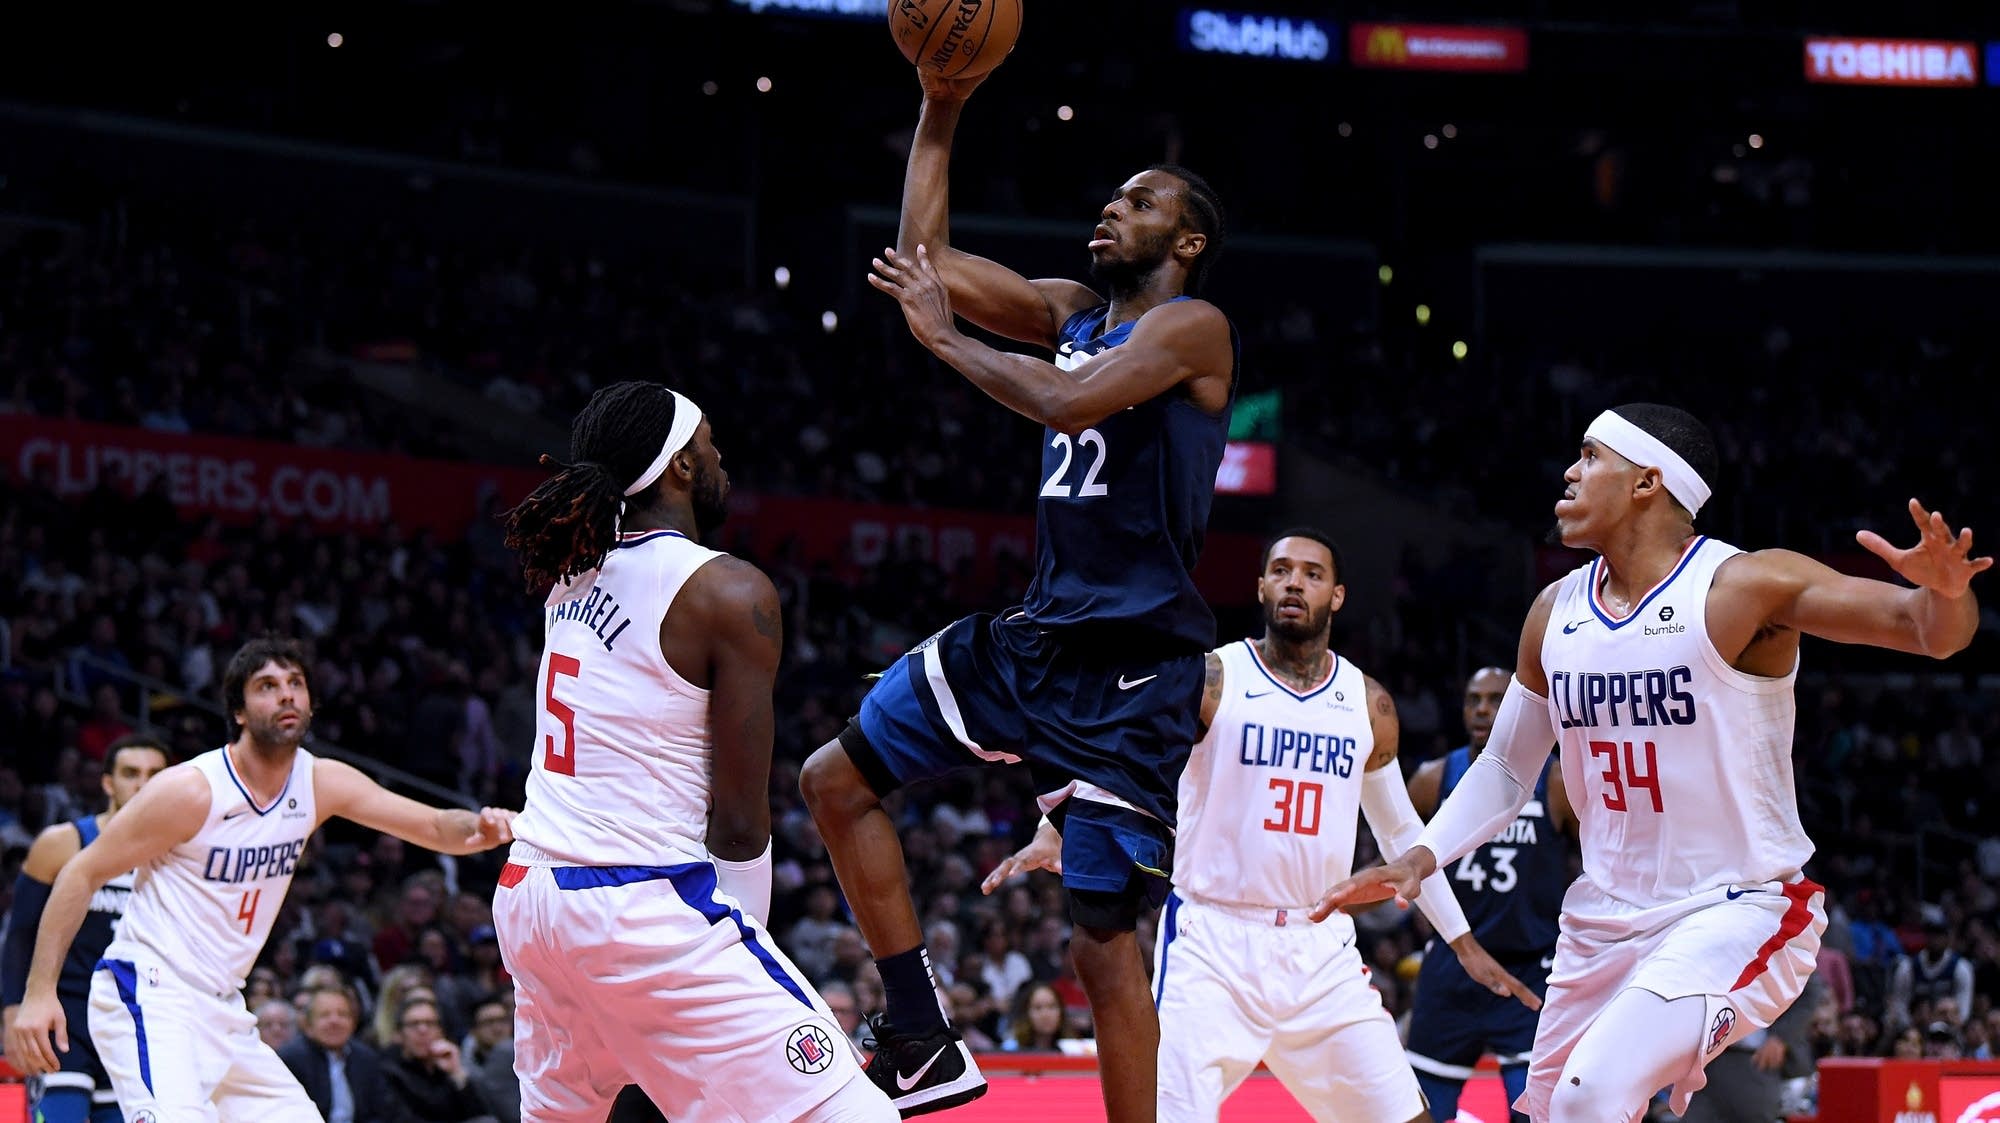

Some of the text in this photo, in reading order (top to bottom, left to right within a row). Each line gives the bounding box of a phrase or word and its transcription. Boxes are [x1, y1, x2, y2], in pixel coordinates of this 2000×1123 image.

[1807, 42, 1975, 81] TOSHIBA
[1040, 428, 1108, 497] 22
[1644, 623, 1686, 636] bumble
[544, 652, 580, 777] 5
[1552, 665, 1697, 730] CLIPPERS
[1240, 722, 1356, 779] CLIPPERS
[1589, 741, 1664, 813] 34
[1264, 778, 1323, 836] 30
[204, 838, 305, 884] CLIPPERS
[1455, 847, 1518, 893] 43
[238, 889, 261, 935] 4
